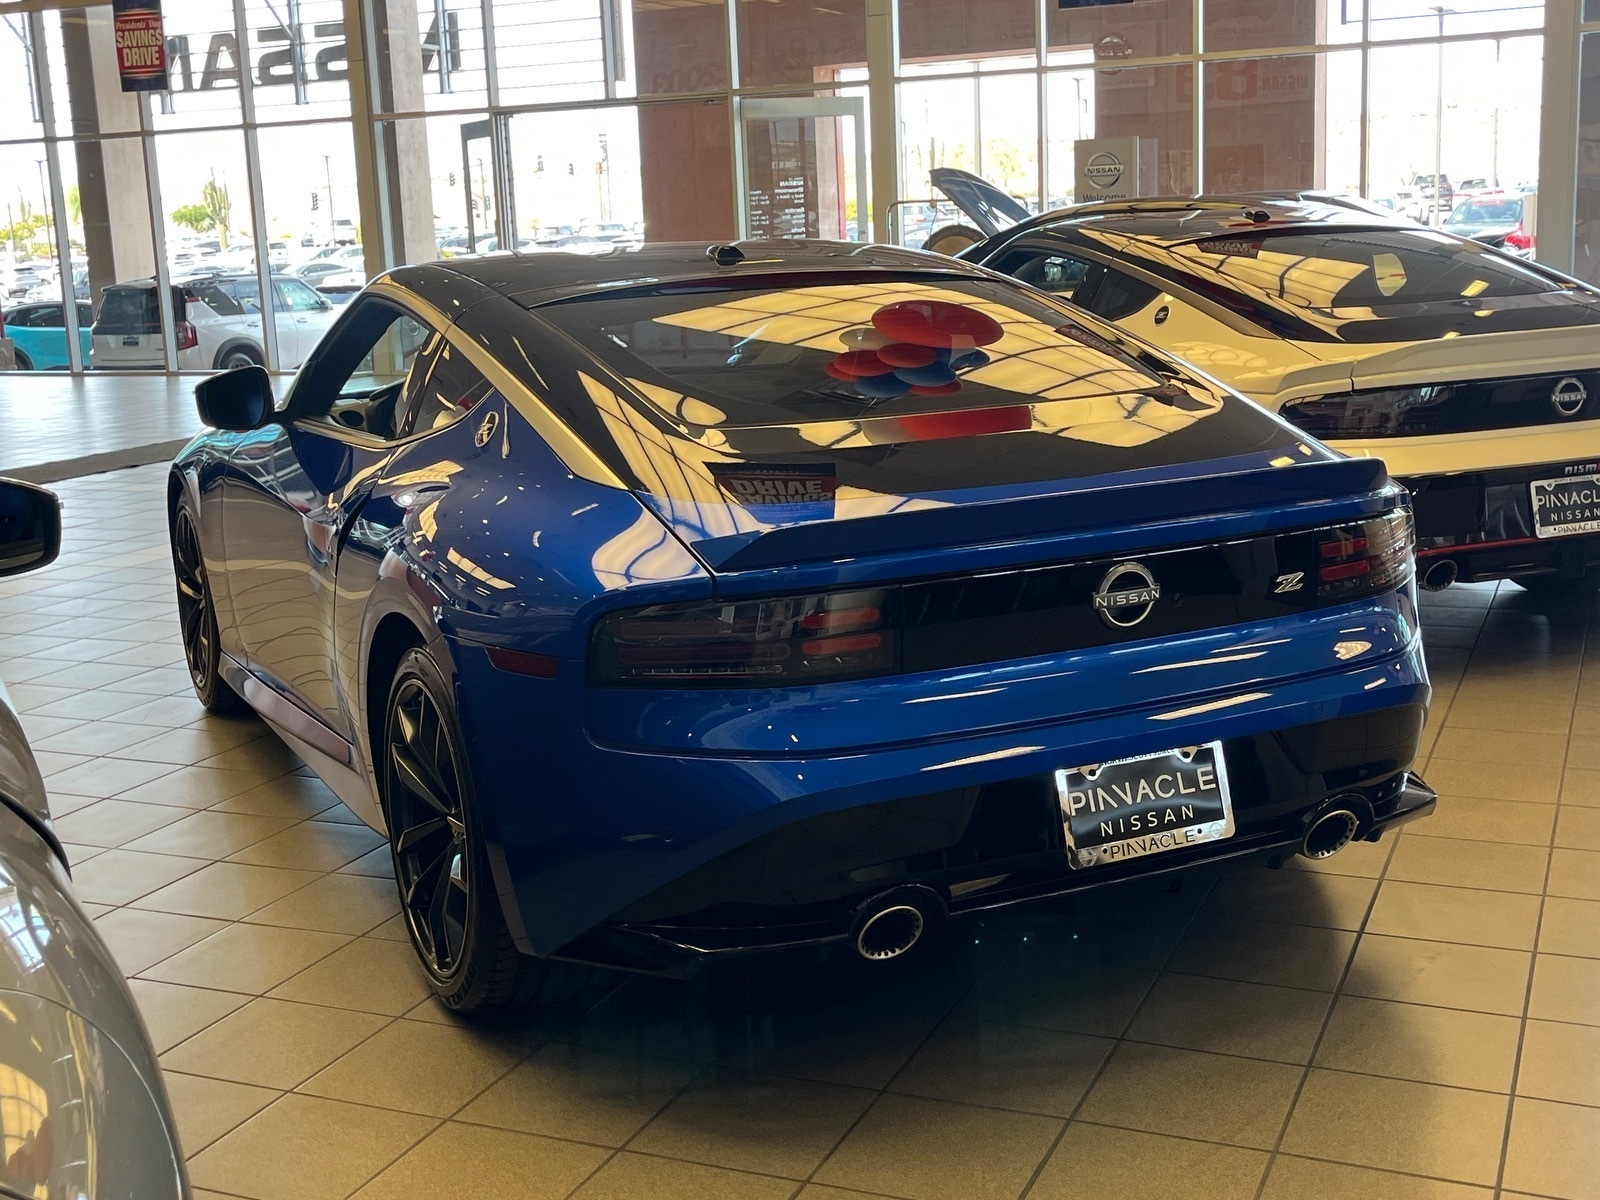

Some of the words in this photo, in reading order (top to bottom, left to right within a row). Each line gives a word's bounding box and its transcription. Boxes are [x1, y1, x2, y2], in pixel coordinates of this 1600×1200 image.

[148, 19, 161, 29] Day
[116, 29, 163, 48] SAVINGS
[123, 47, 160, 67] DRIVE
[1087, 166, 1121, 174] NISSAN
[1083, 193, 1127, 201] Welcome
[1552, 393, 1587, 402] NISSAN
[1564, 463, 1600, 475] nism
[1536, 489, 1600, 508] PINNACL
[1551, 507, 1600, 522] NISSAN
[1274, 571, 1304, 594] Z
[1095, 588, 1160, 608] NISSAN
[1100, 804, 1194, 837] NISSAN
